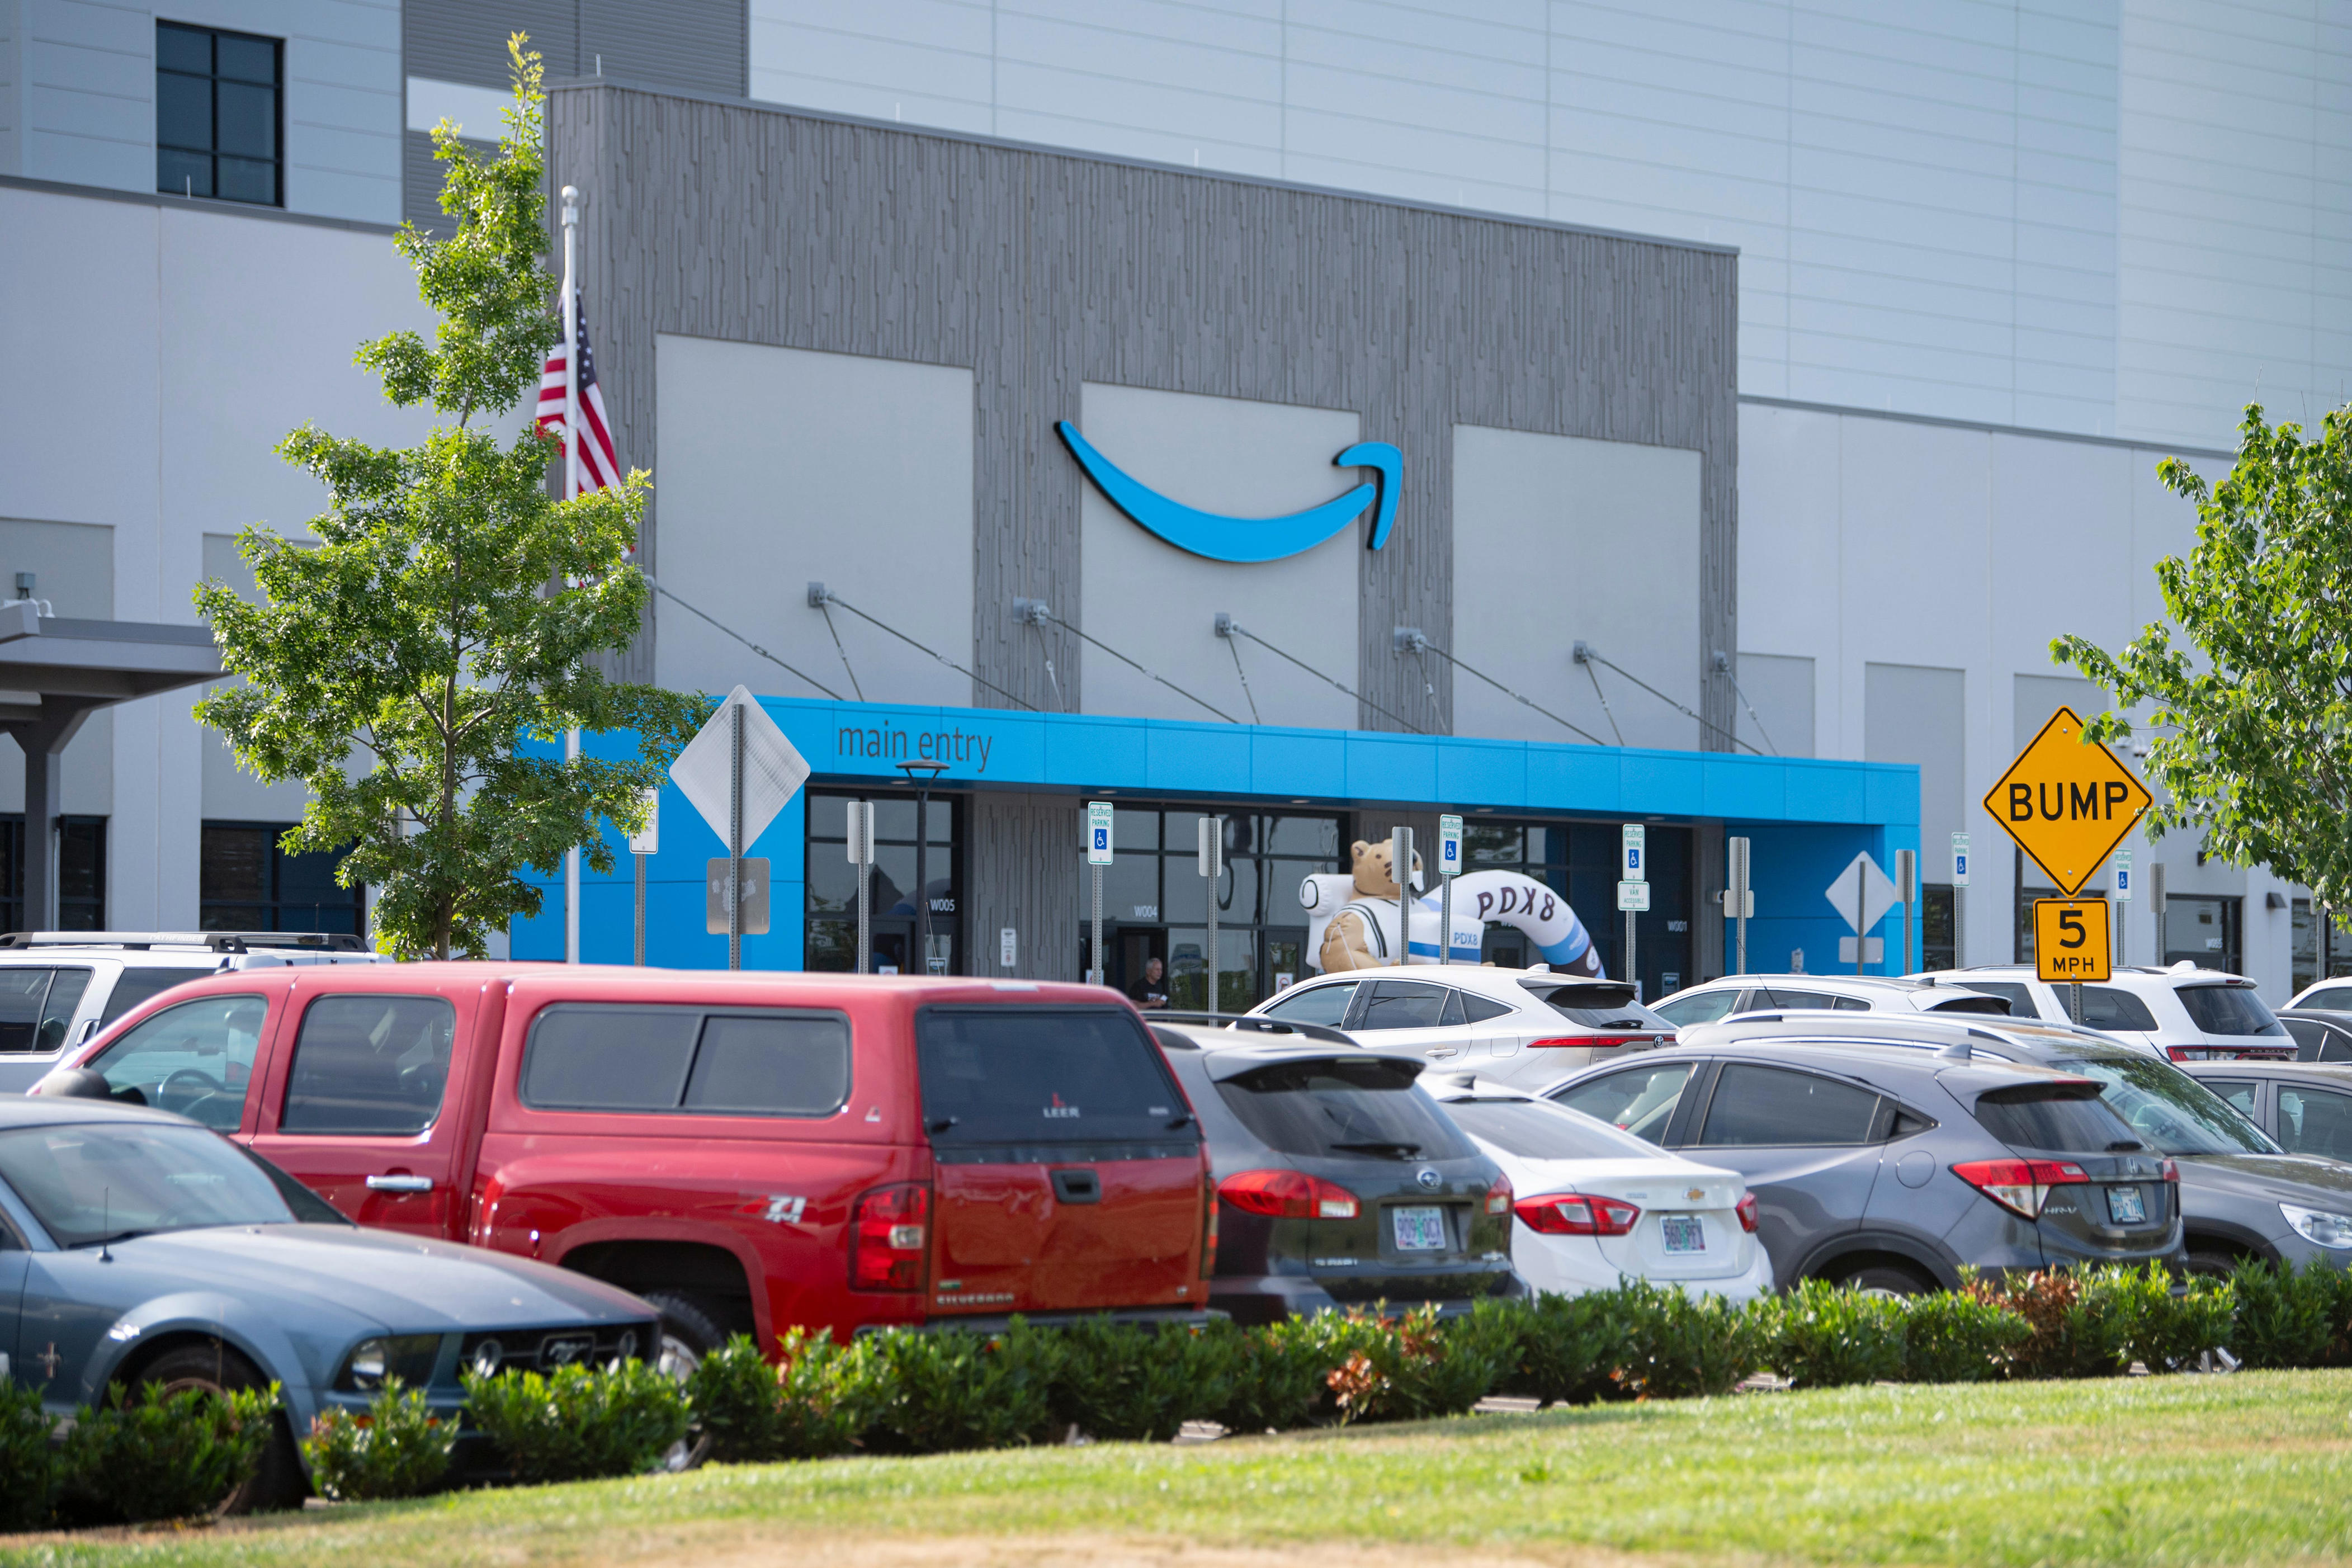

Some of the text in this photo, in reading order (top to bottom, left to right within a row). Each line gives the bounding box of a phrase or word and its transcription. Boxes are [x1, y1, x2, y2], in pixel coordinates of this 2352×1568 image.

[839, 720, 992, 773] main entry
[2009, 781, 2128, 821] BUMP
[1092, 819, 1109, 827] PARKING
[1442, 821, 1461, 830] RESERVED
[1443, 831, 1459, 839] PARKING
[930, 899, 955, 911] W005
[1477, 886, 1555, 921] PDX8
[1134, 905, 1158, 917] W004
[2060, 910, 2086, 948] 5
[1454, 932, 1478, 946] PDX8
[2053, 957, 2094, 972] MPH
[1043, 1107, 1080, 1118] LEER
[2044, 1206, 2077, 1215] HR-V
